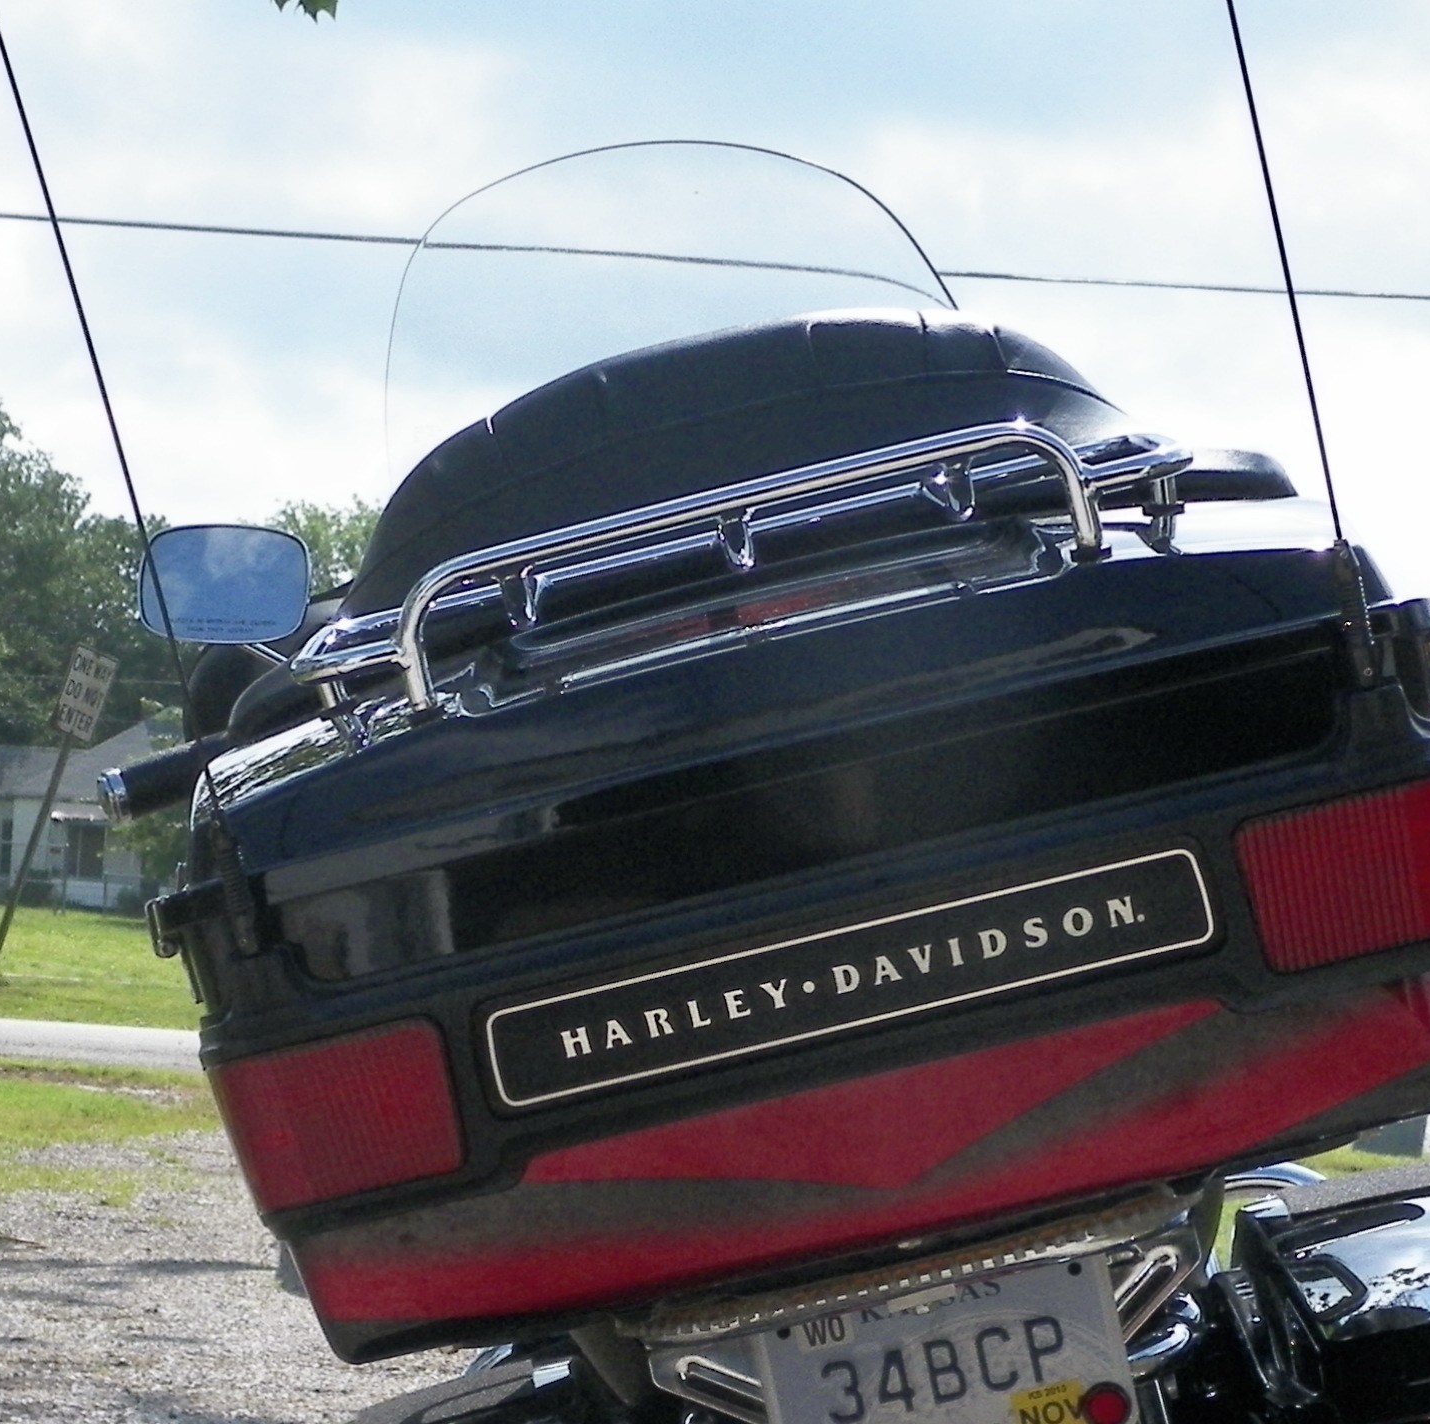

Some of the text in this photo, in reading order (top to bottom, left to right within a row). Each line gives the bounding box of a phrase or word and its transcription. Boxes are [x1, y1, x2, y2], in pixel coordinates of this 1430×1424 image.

[73, 653, 94, 676] ONE
[65, 679, 82, 699] DO
[60, 703, 93, 733] ENTER
[820, 1316, 1063, 1424] 34BCP
